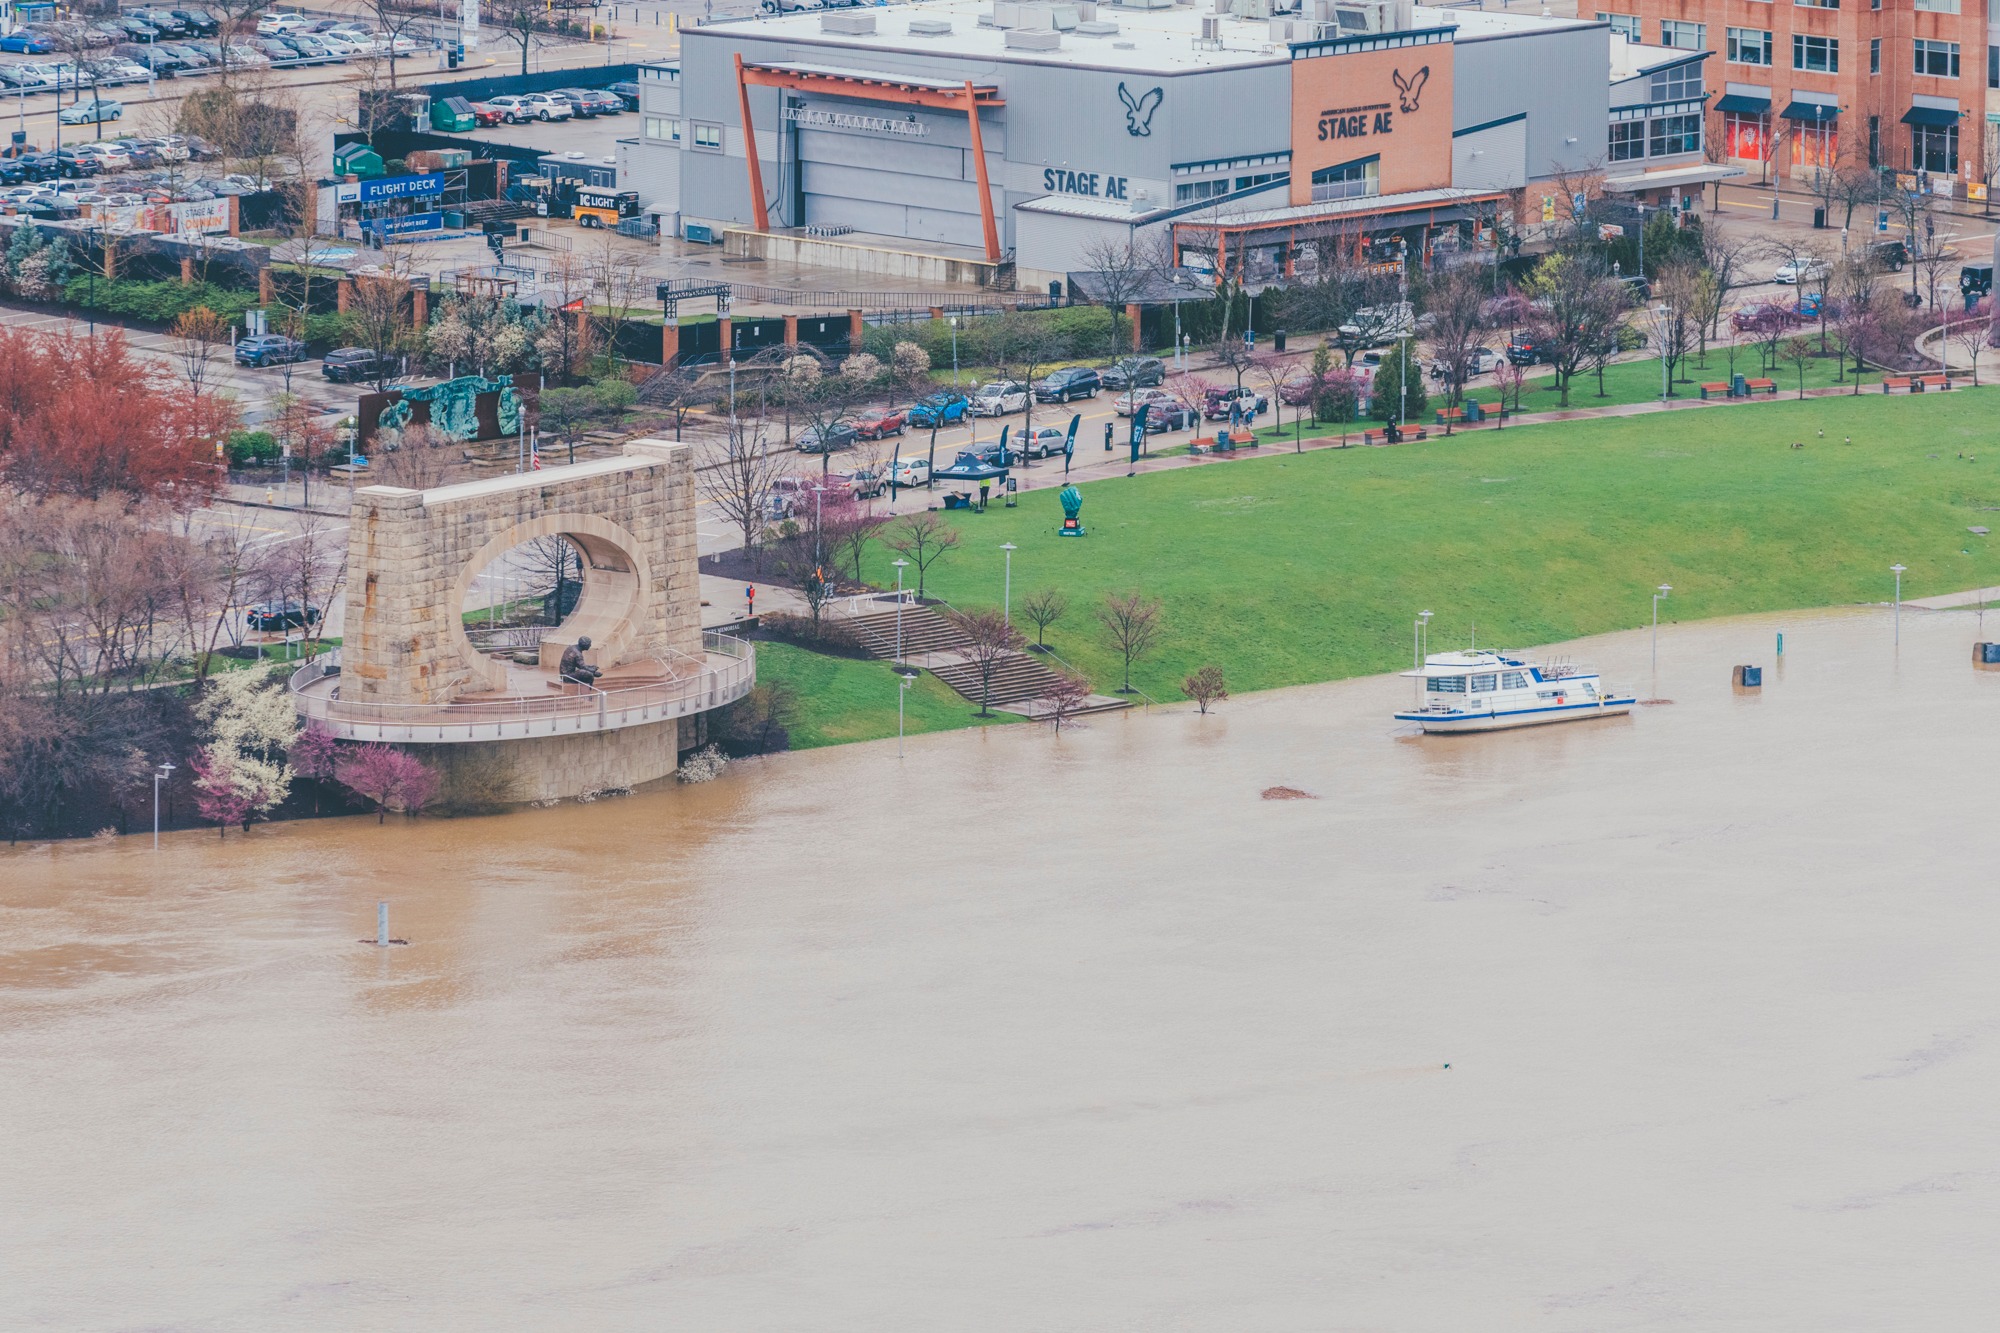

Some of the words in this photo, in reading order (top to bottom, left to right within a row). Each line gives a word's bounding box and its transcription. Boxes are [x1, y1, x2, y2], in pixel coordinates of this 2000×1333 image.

[1318, 114, 1367, 141] STAGE
[1373, 111, 1393, 135] AE
[370, 182, 406, 196] FLIGHT
[409, 179, 436, 191] DECK
[1043, 168, 1099, 196] STAGE
[1105, 176, 1128, 200] AE
[580, 194, 590, 207] IC
[592, 198, 614, 208] LIGHT
[185, 208, 206, 217] STAGE
[718, 624, 740, 633] MEMORIAL
